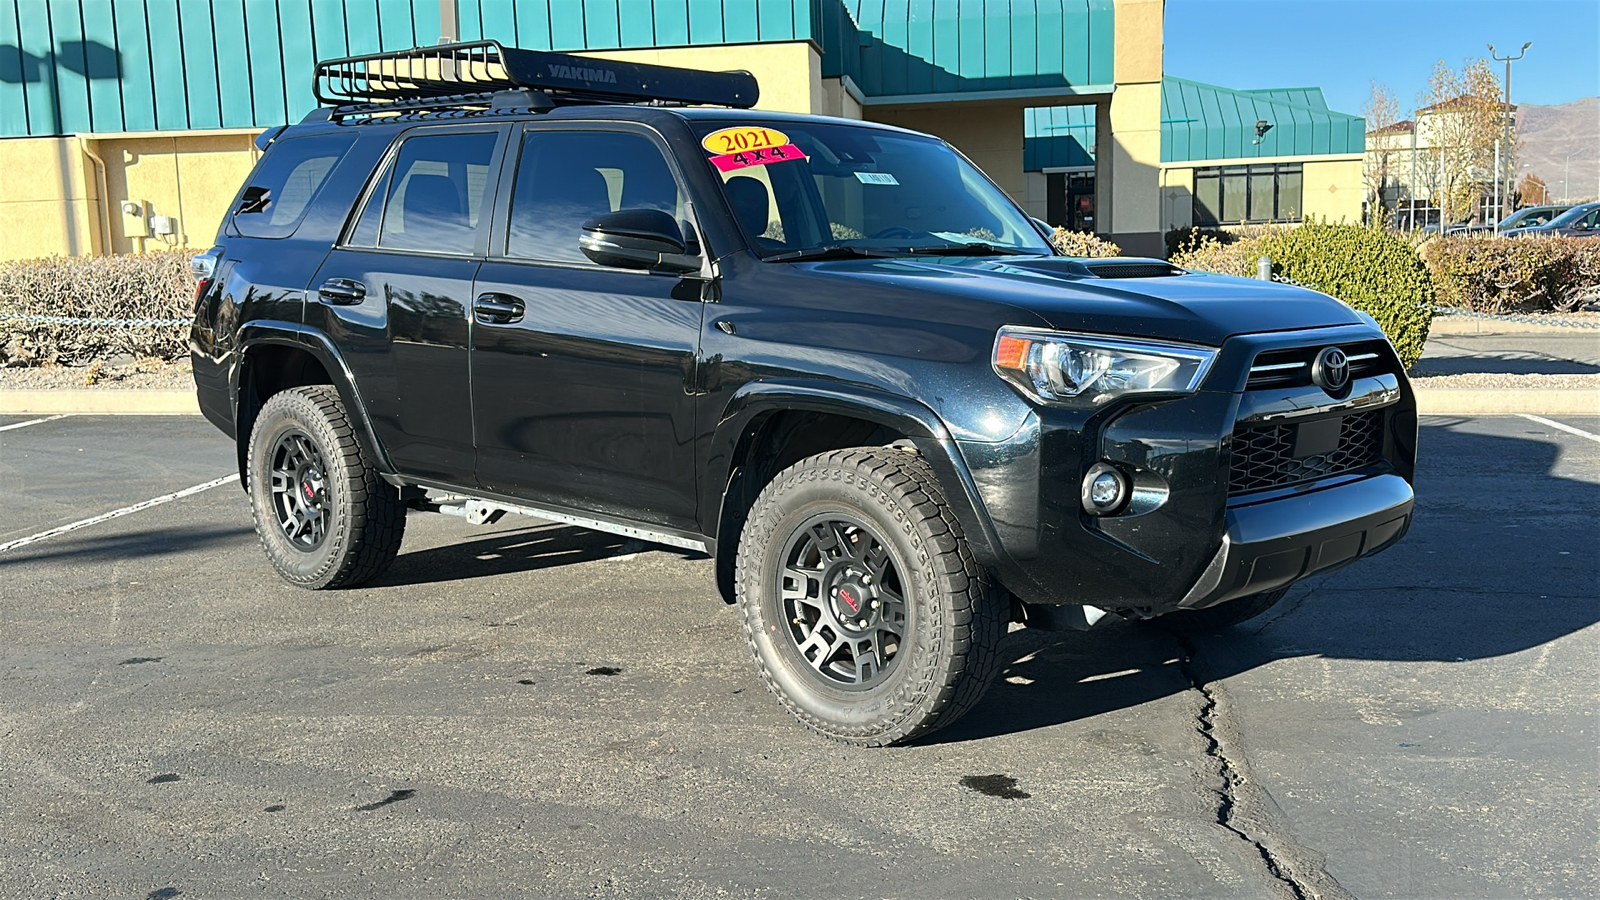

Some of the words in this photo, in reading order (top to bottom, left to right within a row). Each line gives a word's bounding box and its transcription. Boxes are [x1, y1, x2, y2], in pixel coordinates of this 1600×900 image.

[547, 63, 617, 84] YAKIMA
[719, 130, 773, 152] 2021
[749, 504, 786, 587] TERRAIN
